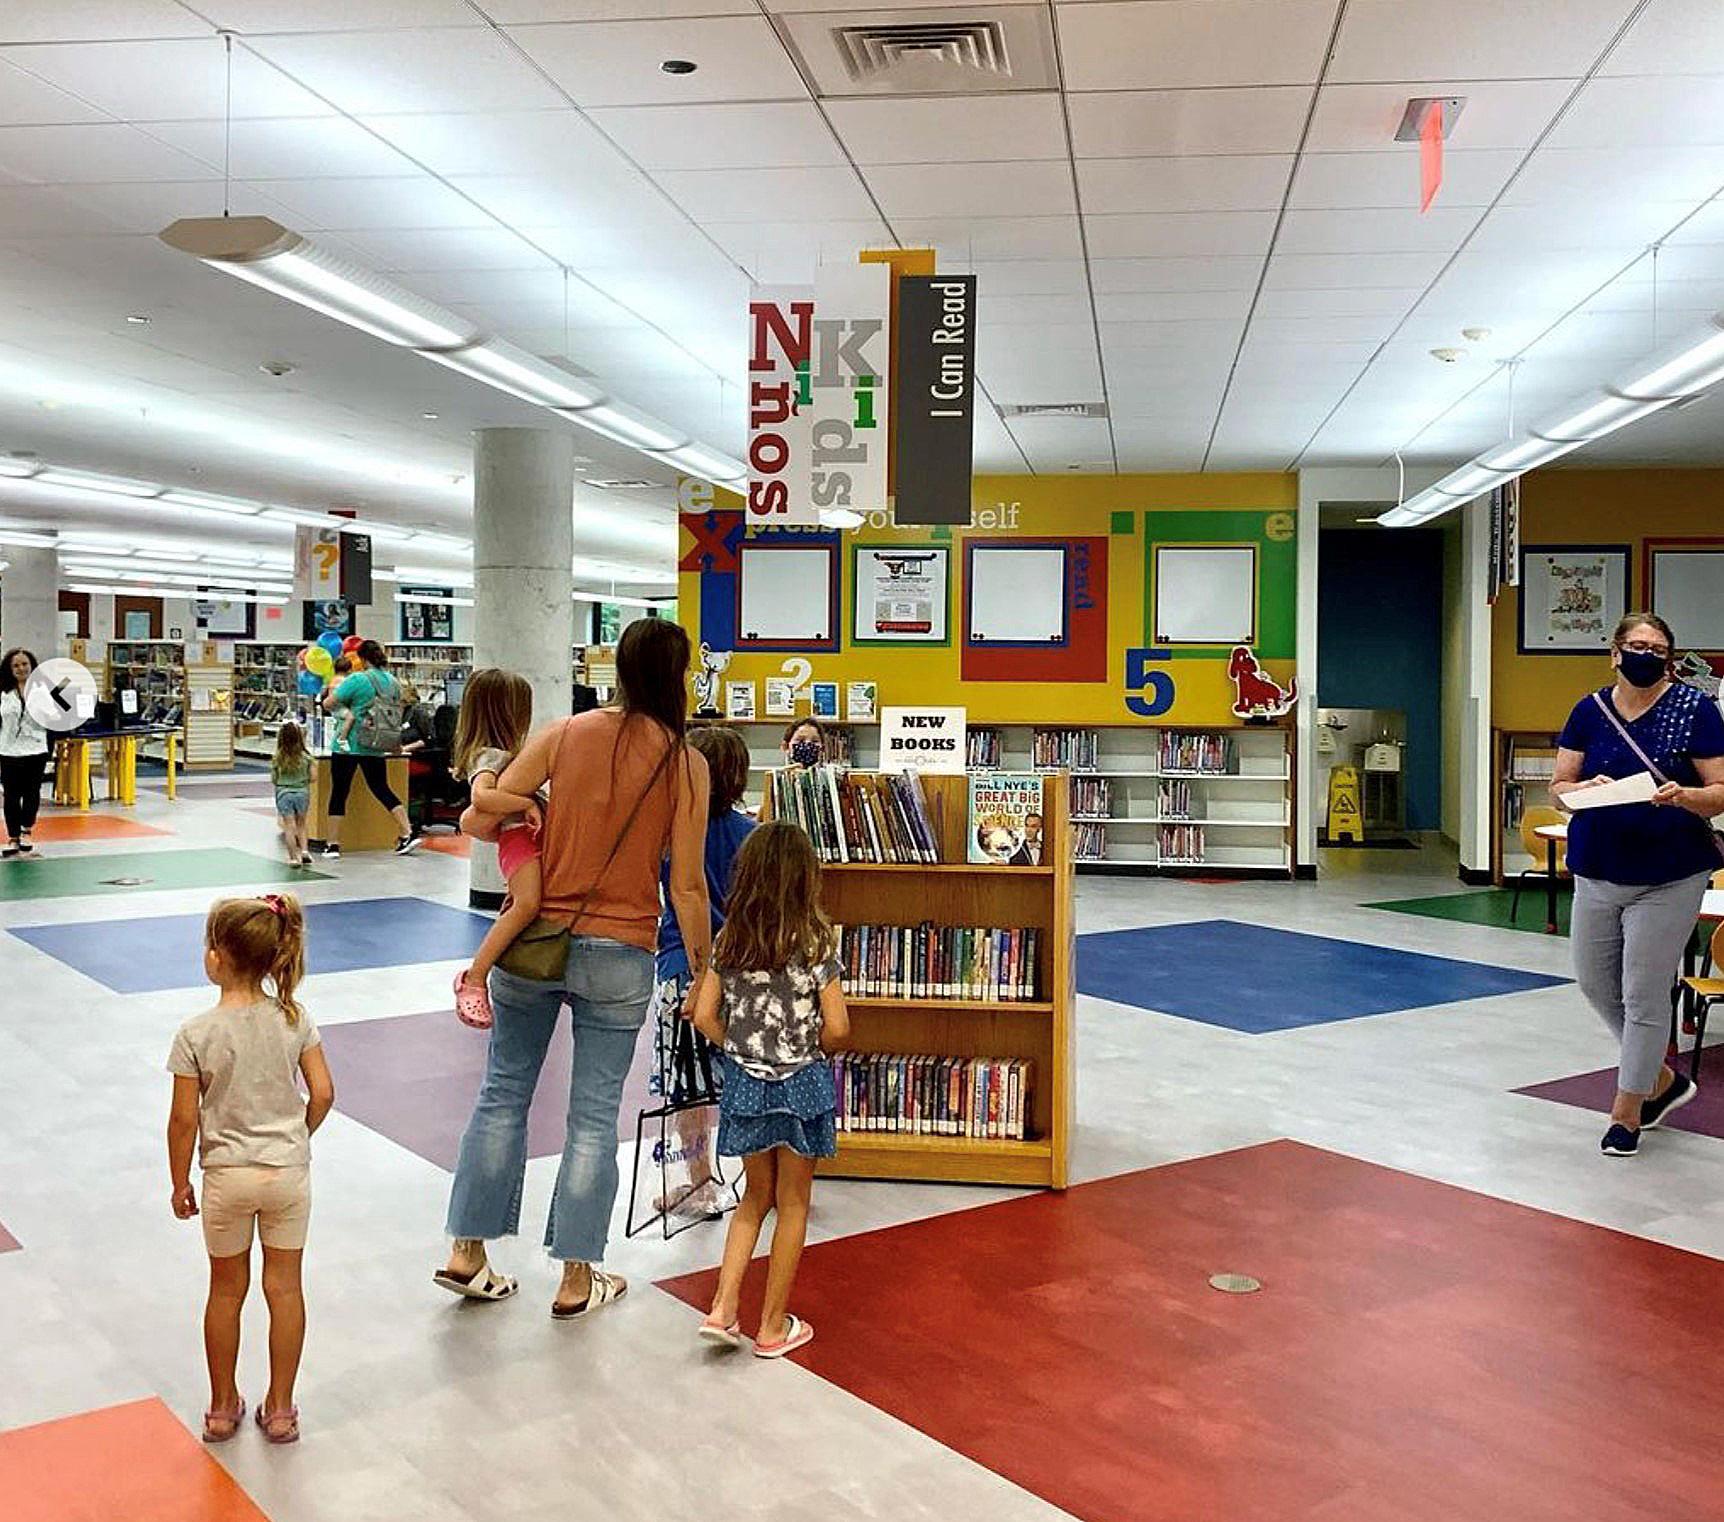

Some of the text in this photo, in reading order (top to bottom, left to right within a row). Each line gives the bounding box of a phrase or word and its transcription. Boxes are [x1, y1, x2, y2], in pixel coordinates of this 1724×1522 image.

[930, 282, 966, 343] Read
[931, 354, 964, 400] Can
[811, 319, 883, 506] Kids
[1124, 648, 1176, 718] 5
[902, 716, 946, 729] NEW
[890, 738, 956, 751] BOOKS
[975, 791, 1016, 803] GREAT
[975, 802, 1023, 814] WORLD
